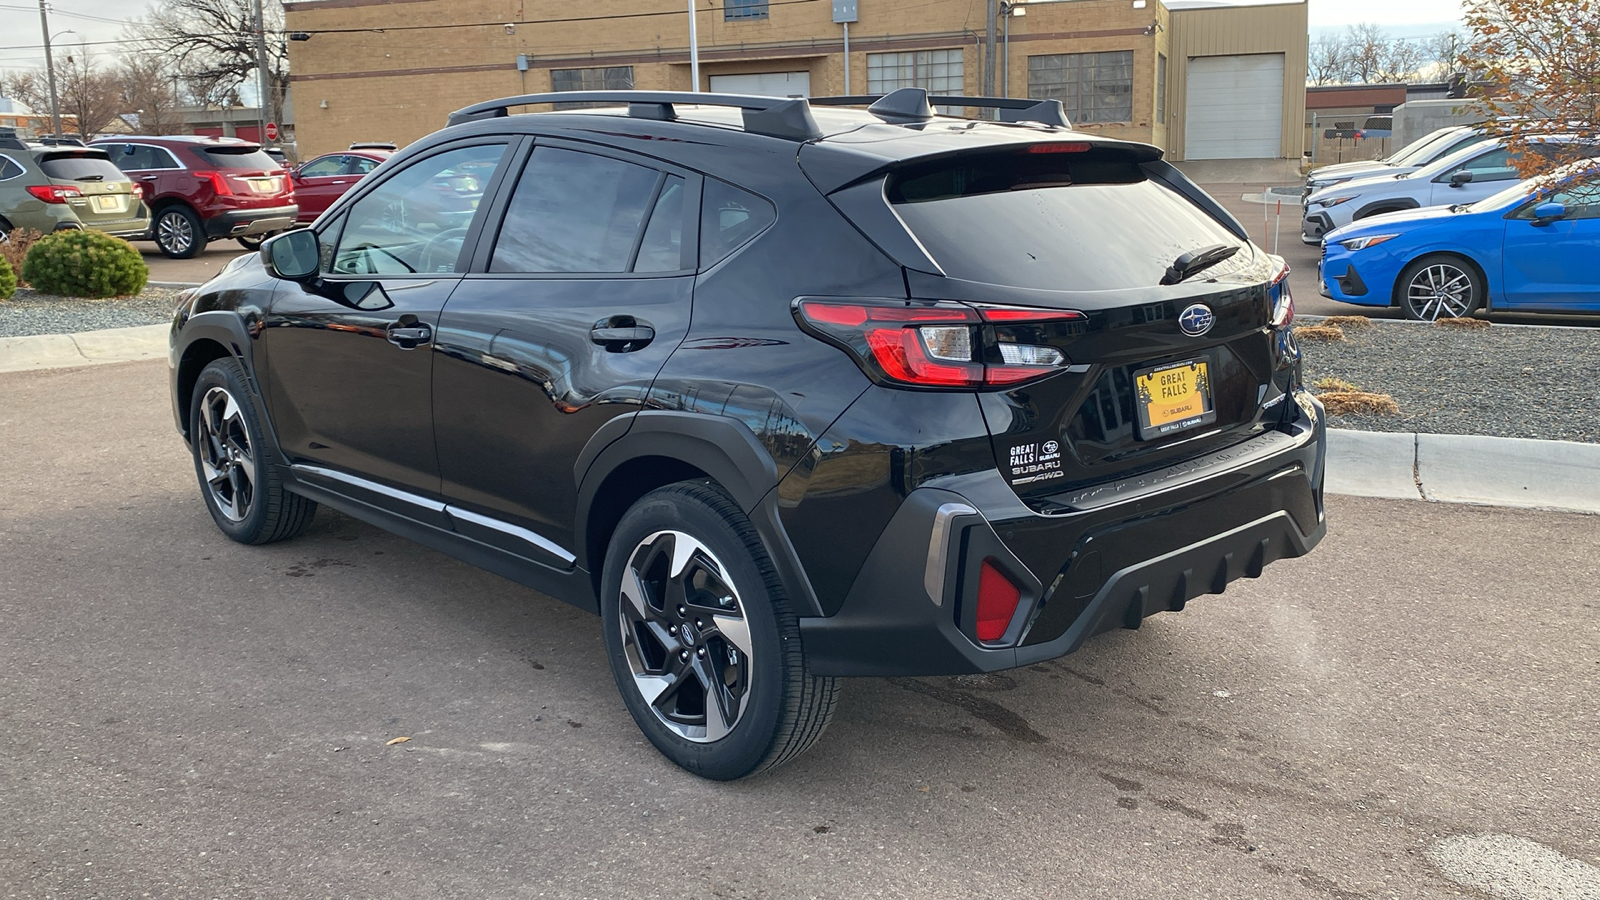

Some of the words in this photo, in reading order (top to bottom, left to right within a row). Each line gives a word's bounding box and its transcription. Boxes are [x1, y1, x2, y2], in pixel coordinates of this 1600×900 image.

[1161, 372, 1186, 386] GREAT
[1162, 384, 1188, 398] FALLS
[1170, 405, 1192, 415] SUBARU
[1010, 444, 1034, 456] GREAT
[1010, 453, 1034, 466] FALLS
[1039, 452, 1060, 461] SUBARU
[1012, 460, 1060, 475] SUBARU
[1032, 470, 1064, 482] AWD
